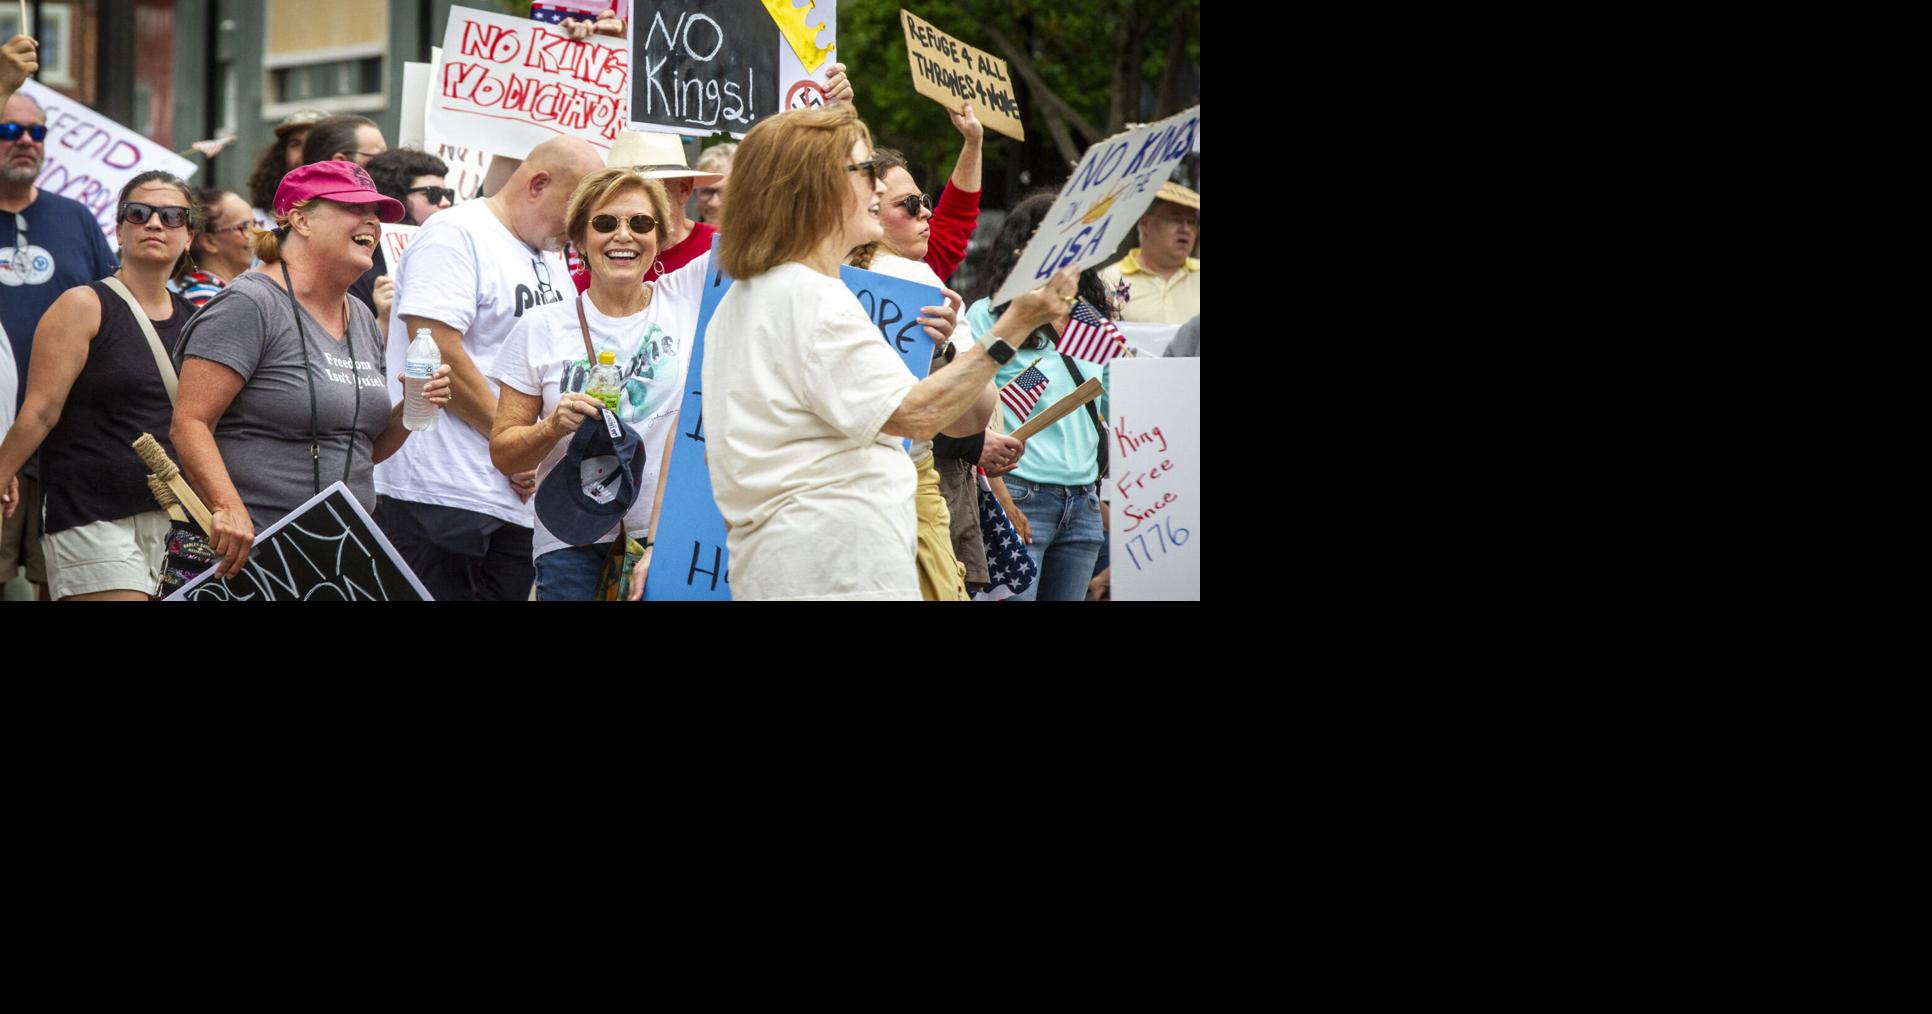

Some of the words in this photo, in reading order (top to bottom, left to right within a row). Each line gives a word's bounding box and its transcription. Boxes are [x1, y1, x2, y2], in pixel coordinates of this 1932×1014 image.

[460, 20, 520, 64] NO
[645, 10, 723, 62] NO
[906, 14, 960, 63] REFUGE
[961, 46, 973, 70] 4
[978, 53, 1007, 82] ALL
[645, 55, 755, 126] Kings!
[911, 50, 977, 100] THRONES
[976, 78, 987, 106] 4
[987, 82, 1021, 120] NONE
[1065, 141, 1128, 198] NO
[1034, 214, 1113, 280] USA
[324, 352, 372, 370] Freedom
[324, 369, 352, 385] Isn't
[1115, 416, 1168, 458] King
[1117, 459, 1175, 499] Free
[1123, 492, 1178, 532] Since
[1126, 515, 1190, 570] 1776
